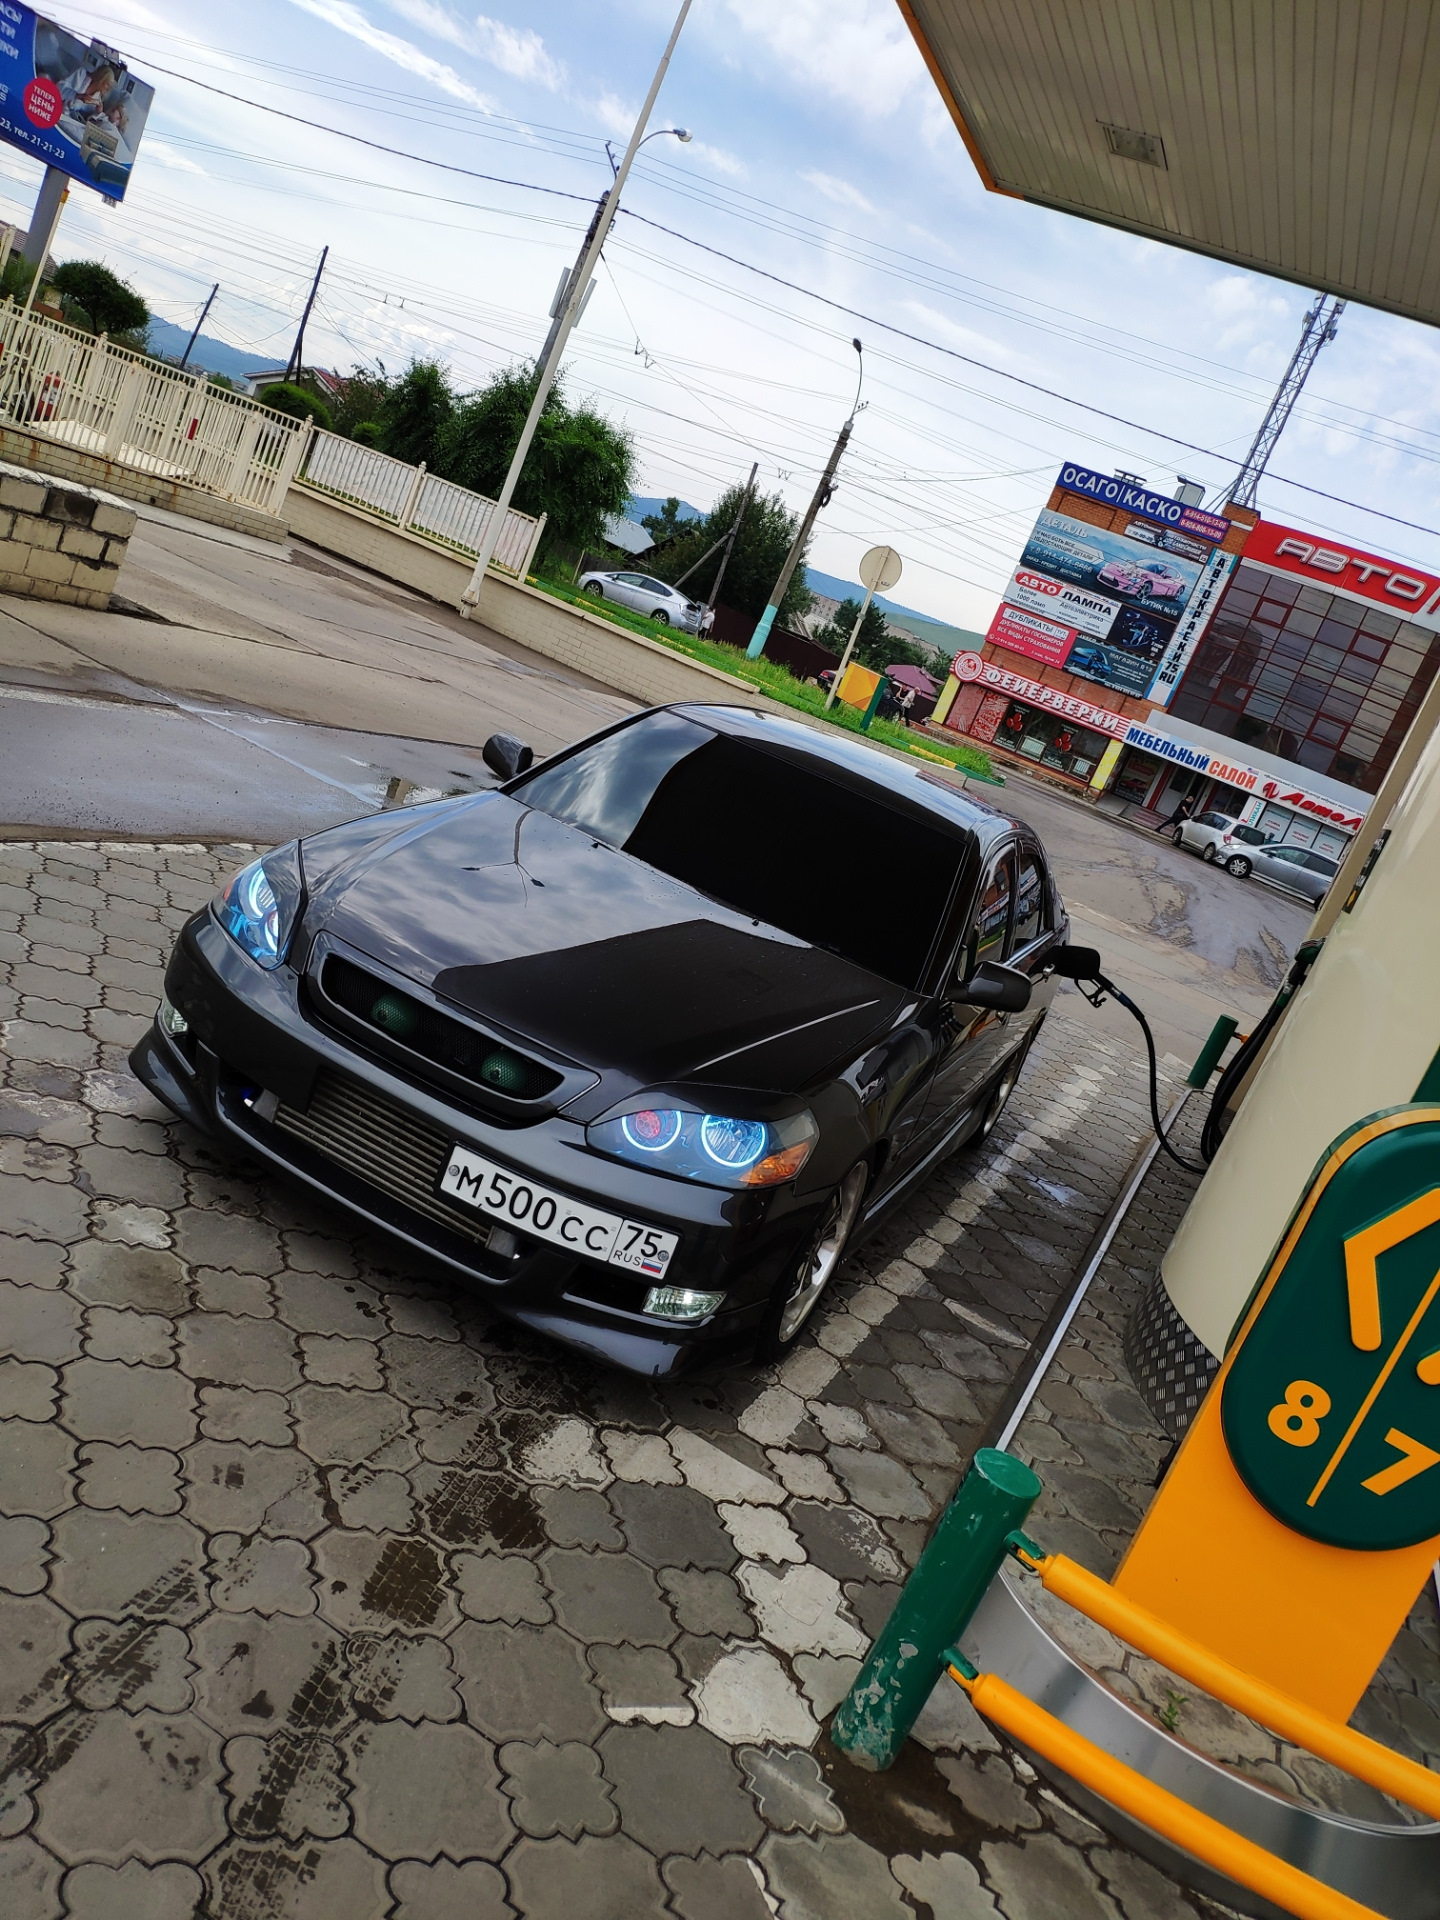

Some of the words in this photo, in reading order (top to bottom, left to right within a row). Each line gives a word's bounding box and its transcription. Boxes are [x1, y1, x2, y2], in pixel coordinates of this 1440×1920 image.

[31, 95, 55, 113] ЦЕНЫ
[34, 85, 56, 104] ТЕПЕРЬ
[28, 104, 53, 122] НИЖЕ
[13, 126, 30, 141] тел.
[31, 133, 66, 160] 21-21-23
[1062, 466, 1118, 498] ОСАГО
[1123, 491, 1182, 522] КАСКО
[1040, 513, 1090, 538] ДЕТАЛЬ
[1072, 549, 1093, 560] ДЕТАЛИ
[1275, 537, 1427, 601] АВТО
[1018, 575, 1057, 595] АВТО
[1061, 590, 1113, 615] ЛАМПА
[1140, 598, 1162, 610] БУТИК
[999, 618, 1030, 634] ДУБЛИКАТЫ
[1030, 630, 1064, 647] ГОСНОМЕРОВ
[1007, 610, 1054, 633] ДУБЛИКАТЫ
[996, 625, 1006, 633] ВСЕ
[1006, 629, 1023, 640] ВИДЫ
[1022, 635, 1060, 654] СТРАХОВАНИЯ
[1108, 652, 1139, 667] МАГАЗИН
[1158, 670, 1176, 684] RU
[1126, 727, 1210, 770] МЕБЕЛЬНЫЙ
[1208, 760, 1257, 789] САЛОН
[455, 1165, 608, 1251] М500СС
[621, 1224, 664, 1258] 75
[613, 1249, 642, 1268] RUS
[1268, 1380, 1332, 1448] 8
[1360, 1427, 1440, 1496] 7
